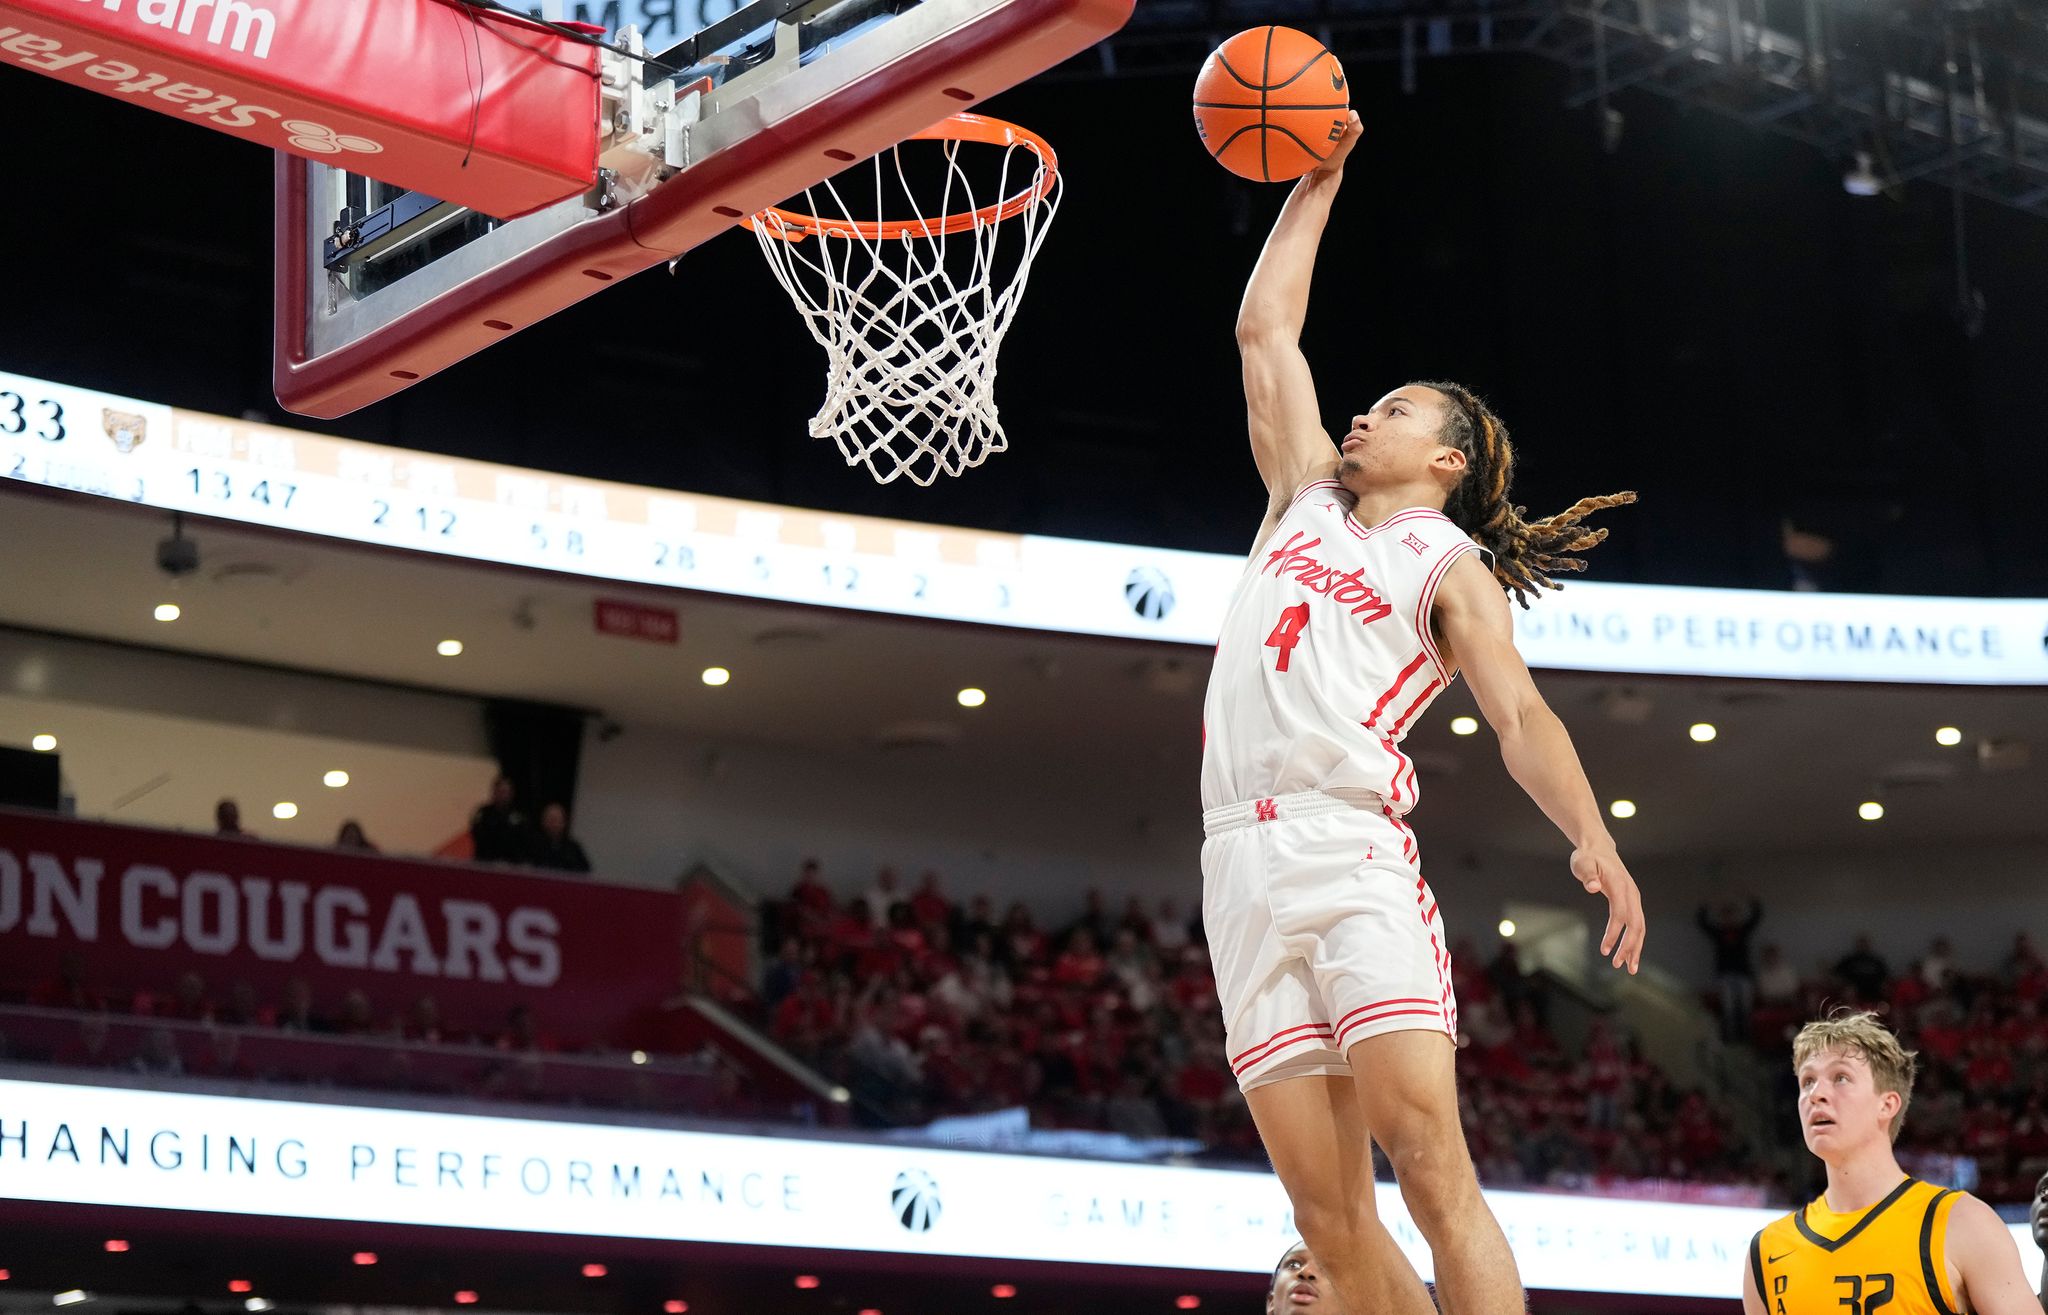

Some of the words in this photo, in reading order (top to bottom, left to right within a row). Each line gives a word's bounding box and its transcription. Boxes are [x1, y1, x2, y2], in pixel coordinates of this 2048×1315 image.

[103, 0, 277, 60] arm
[84, 60, 283, 128] State
[0, 391, 66, 442] 33
[372, 499, 391, 528] 2
[416, 505, 458, 538] 12
[1261, 531, 1393, 626] Houston
[1265, 601, 1310, 673] 4
[1652, 613, 2005, 661] PERFORMANCE
[119, 865, 563, 988] COUGARS
[0, 1117, 310, 1181] HANGING
[350, 1144, 805, 1213] PERFORMANCE
[1834, 1273, 1895, 1315] 32
